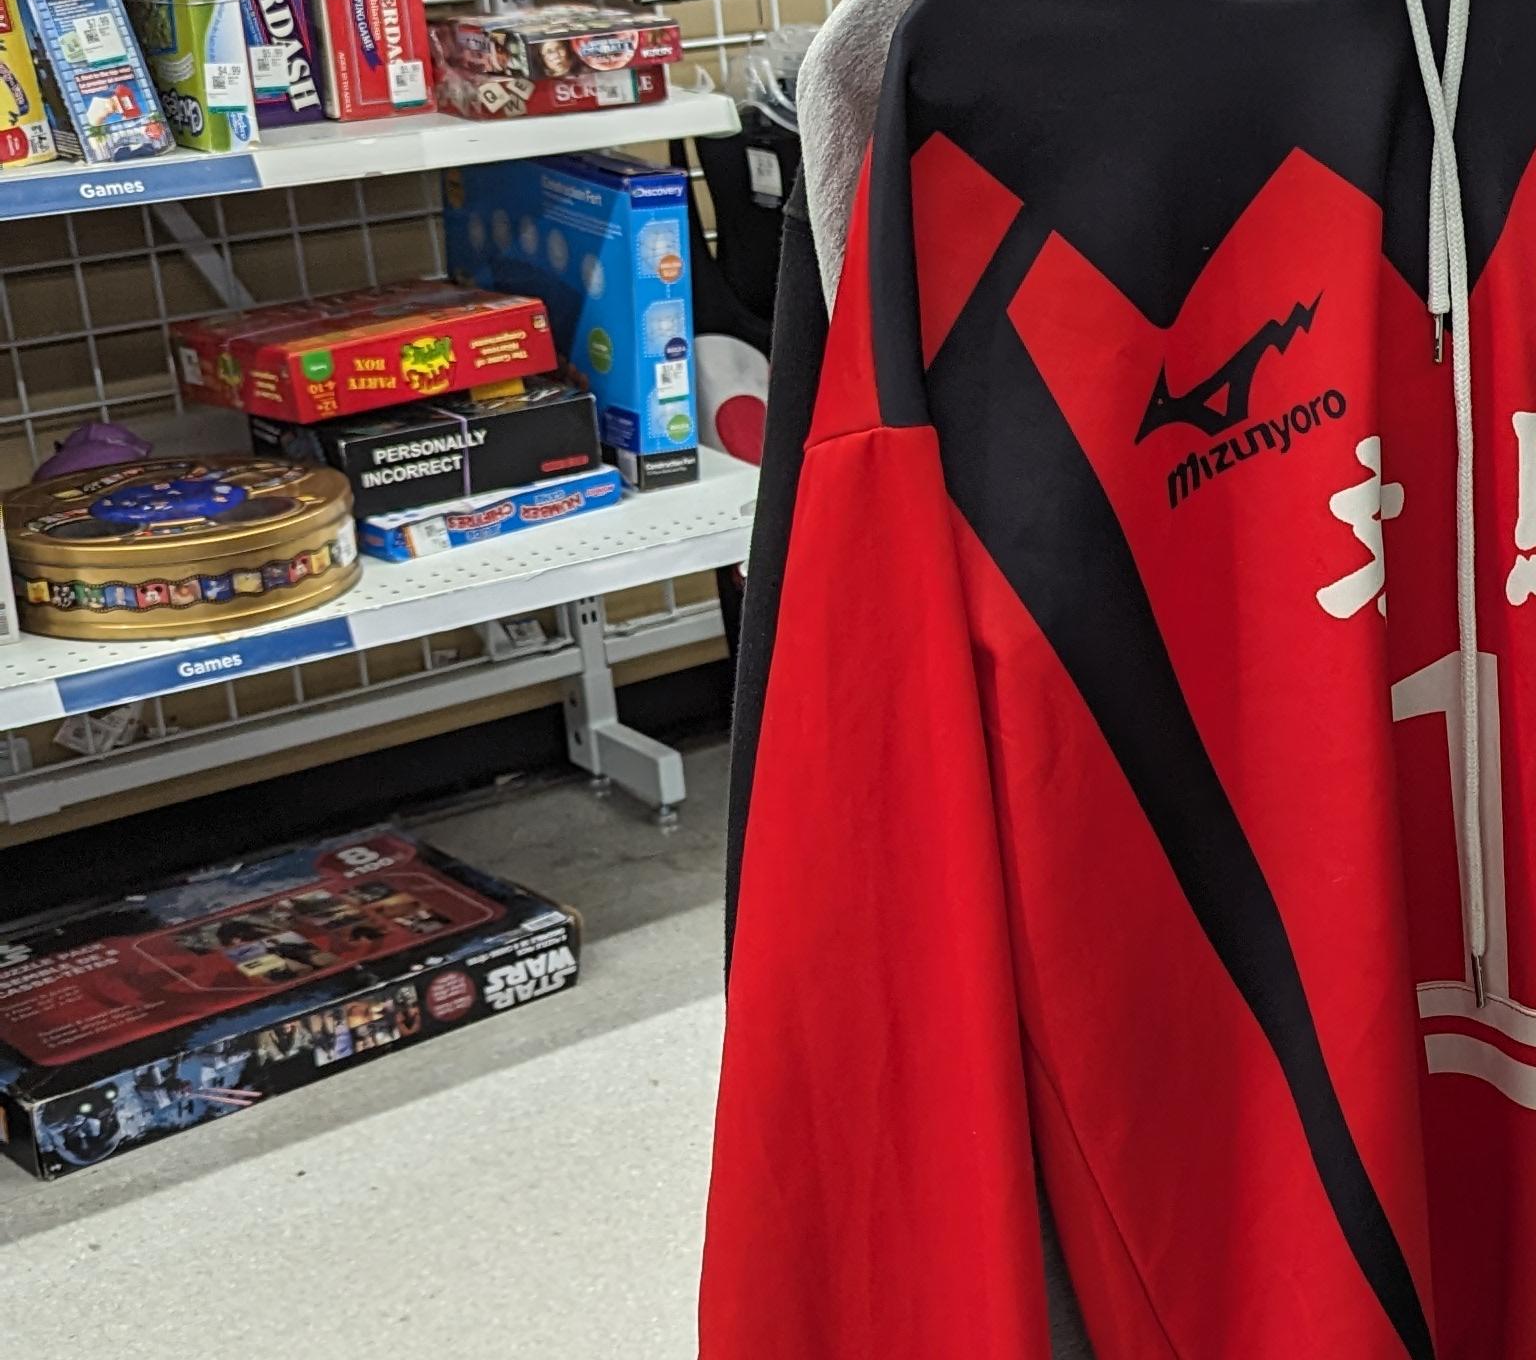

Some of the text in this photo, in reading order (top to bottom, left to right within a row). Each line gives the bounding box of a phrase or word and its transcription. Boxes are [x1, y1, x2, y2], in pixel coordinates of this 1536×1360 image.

[358, 21, 375, 52] GAME
[484, 90, 497, 103] Q
[80, 180, 145, 199] Games
[632, 186, 684, 198] Discovery
[354, 358, 386, 371] BOX
[348, 377, 397, 390] PARTY
[373, 430, 488, 465] PERSONALLY
[1166, 387, 1347, 510] mizunyoro
[361, 454, 464, 489] INCORRECT
[178, 654, 243, 677] Games
[1391, 650, 1510, 1000] 1
[487, 943, 577, 990] WARS
[492, 966, 566, 1010] STAR
